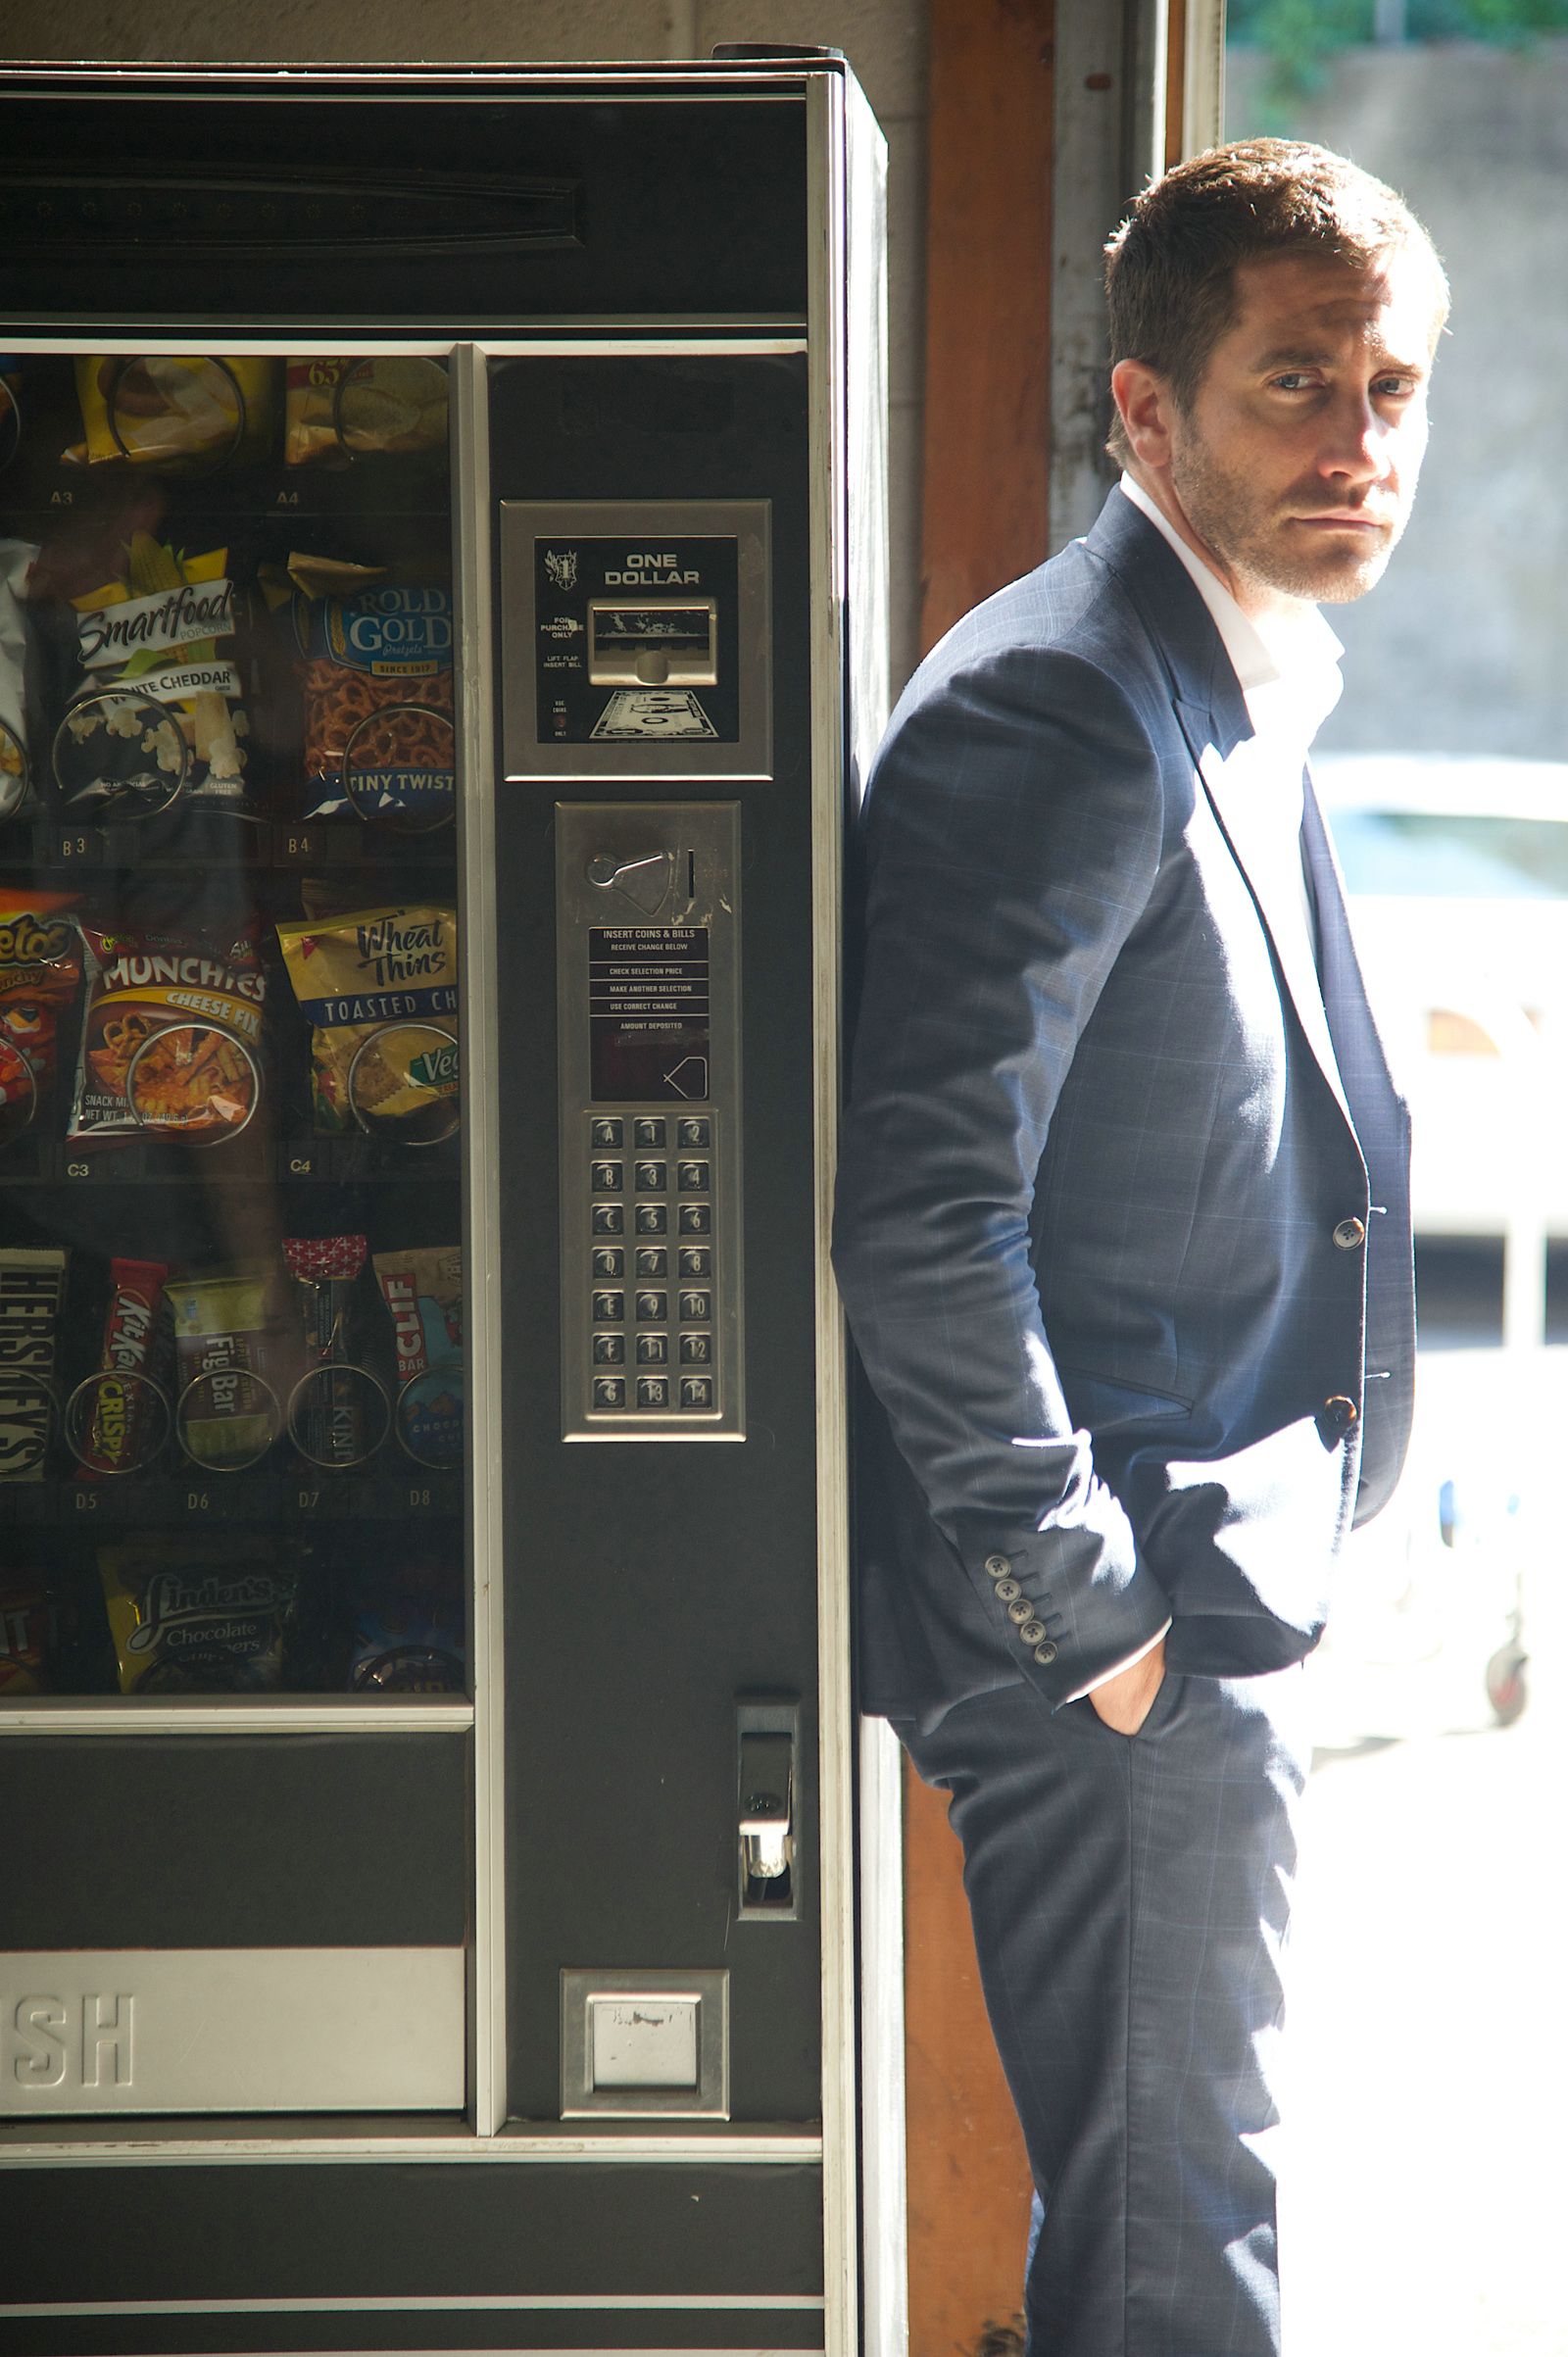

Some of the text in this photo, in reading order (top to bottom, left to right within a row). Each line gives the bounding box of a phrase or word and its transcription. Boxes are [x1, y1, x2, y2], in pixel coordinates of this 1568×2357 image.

[51, 492, 73, 504] A3
[276, 492, 299, 504] A4
[626, 554, 677, 567] ONE
[605, 571, 700, 585] DOLLAR
[359, 588, 447, 616] ROLD
[78, 581, 233, 663] Smartfood
[180, 622, 232, 640] POPCORN
[350, 615, 452, 651] GOLD
[380, 664, 408, 674] SINCE
[161, 670, 231, 690] CHEDDAR
[357, 910, 444, 958] Wheat
[603, 930, 633, 939] INSERT
[672, 929, 695, 938] BILLS
[358, 952, 446, 987] Thins
[103, 956, 267, 1002] MUNCHIES
[166, 991, 261, 1035] CHEESE FIX
[324, 996, 416, 1022] TOASTED
[85, 1095, 130, 1107] SNACK MI
[85, 1110, 100, 1121] NET
[605, 1126, 613, 1142] A
[650, 1126, 656, 1142] 1
[692, 1126, 700, 1142] 2
[68, 1163, 89, 1176] C3
[290, 1159, 312, 1172] C4
[606, 1169, 613, 1185] B
[649, 1169, 658, 1186] 3
[692, 1169, 700, 1184] 4
[607, 1212, 614, 1228] C
[650, 1212, 658, 1228] 5
[693, 1212, 701, 1228] 6
[606, 1255, 615, 1271] D
[651, 1255, 659, 1271] 7
[693, 1255, 701, 1271] 8
[607, 1299, 614, 1315] E
[651, 1299, 658, 1315] 9
[689, 1299, 705, 1314] 10
[387, 1280, 422, 1357] CLIF
[607, 1342, 614, 1358] F
[647, 1342, 662, 1358] 11
[690, 1342, 706, 1357] 12
[398, 1359, 424, 1371] BAR
[202, 1336, 238, 1412] Fig Bar
[607, 1385, 616, 1401] G
[647, 1385, 662, 1401] 13
[690, 1385, 706, 1401] 14
[99, 1380, 125, 1466] CRISPY
[75, 1494, 97, 1509] D5
[187, 1493, 209, 1509] D6
[299, 1493, 319, 1507] D7
[411, 1491, 430, 1505] D8
[126, 1573, 278, 1653] Linden's
[167, 1624, 257, 1646] Chocolate
